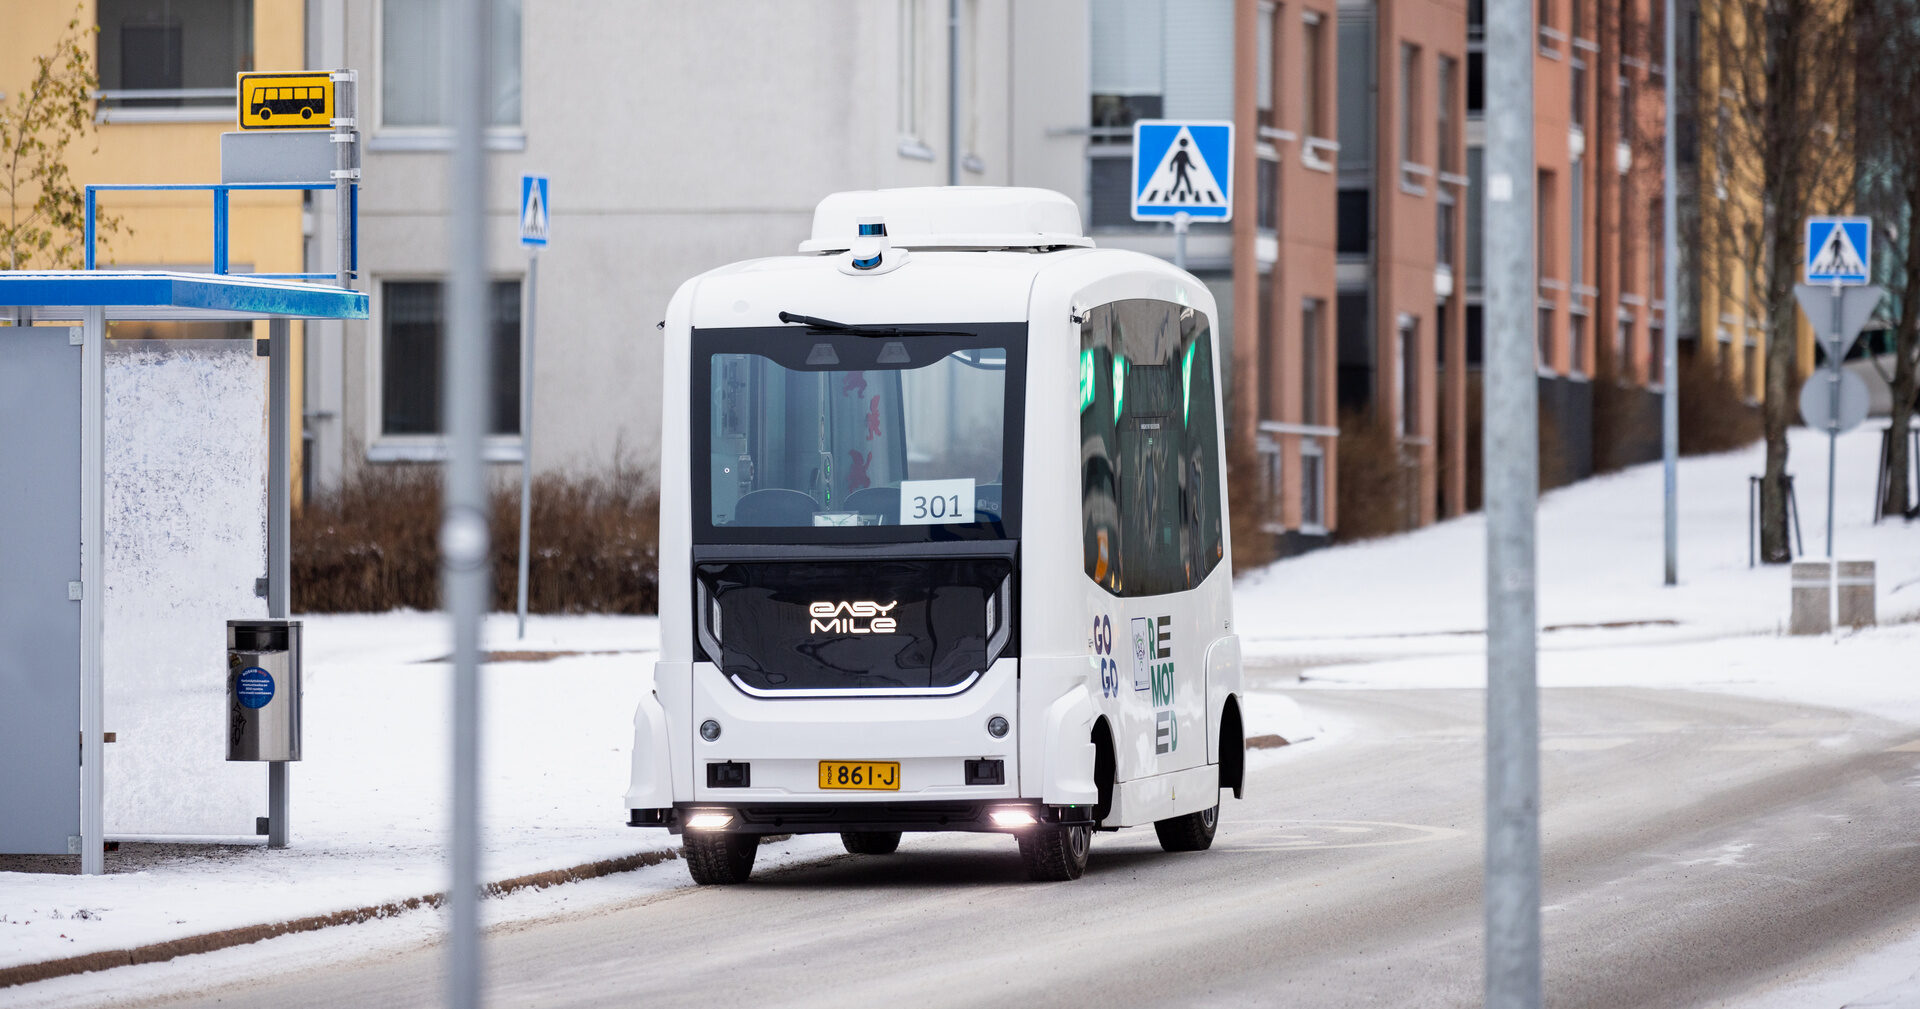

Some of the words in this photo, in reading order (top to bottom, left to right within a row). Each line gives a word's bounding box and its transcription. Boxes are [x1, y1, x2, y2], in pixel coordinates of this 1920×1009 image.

[913, 494, 962, 519] 301
[1093, 614, 1111, 655] GO
[1147, 616, 1171, 660] RE
[1101, 658, 1118, 699] GO
[1151, 662, 1175, 708] MOT
[1155, 710, 1178, 755] ED
